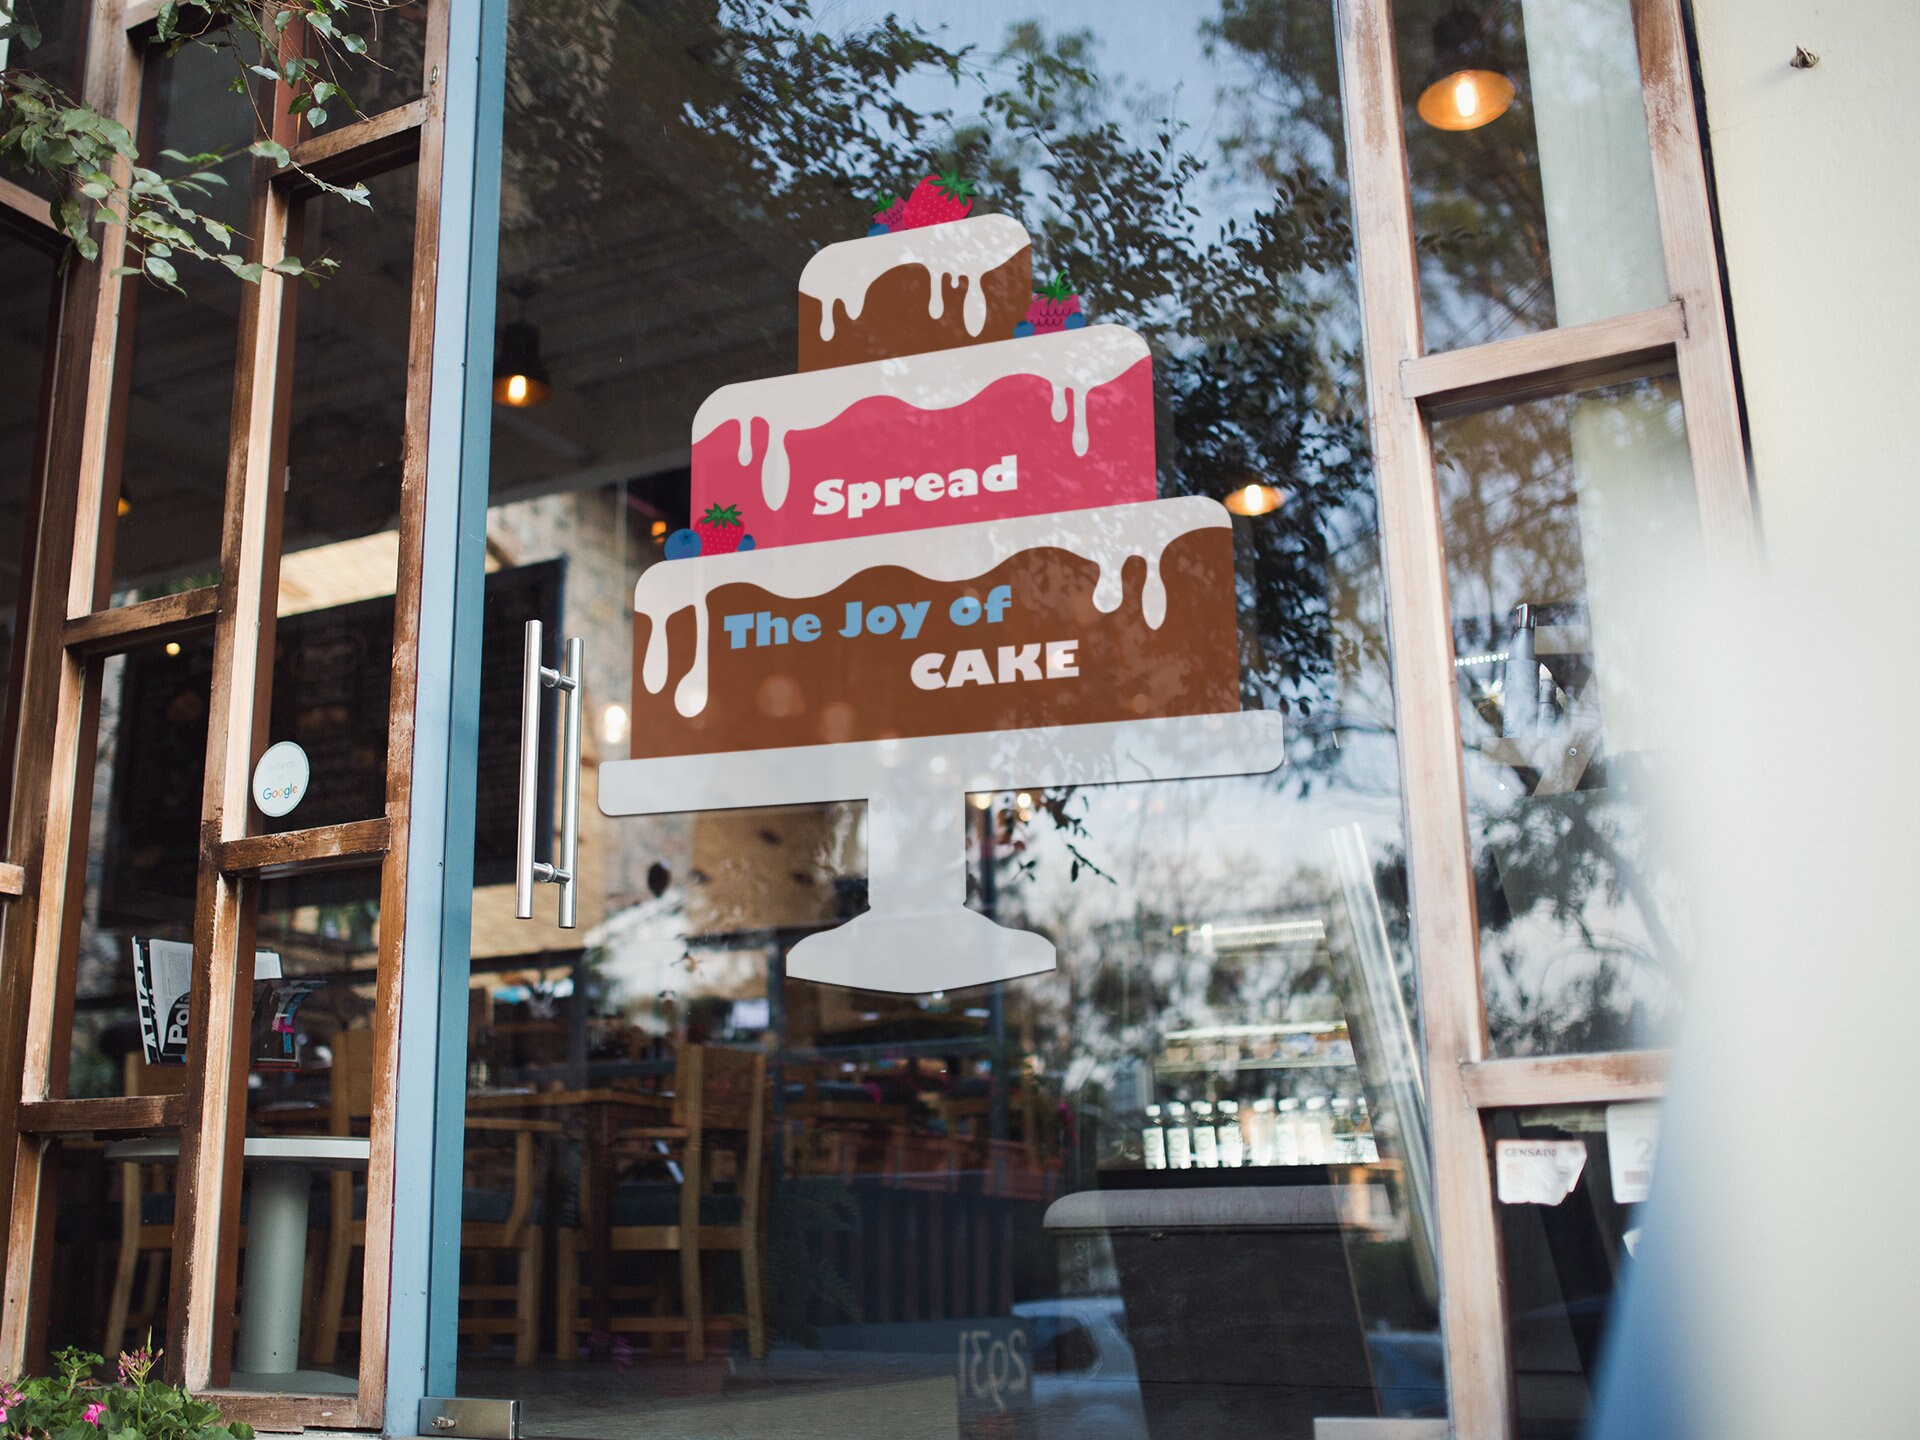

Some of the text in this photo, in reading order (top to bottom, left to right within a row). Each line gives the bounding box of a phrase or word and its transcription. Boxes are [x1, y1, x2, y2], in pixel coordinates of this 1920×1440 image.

[812, 454, 1018, 519] Spread
[723, 585, 1012, 650] The Joy of
[910, 639, 1080, 691] CAKE
[262, 783, 298, 800] Google
